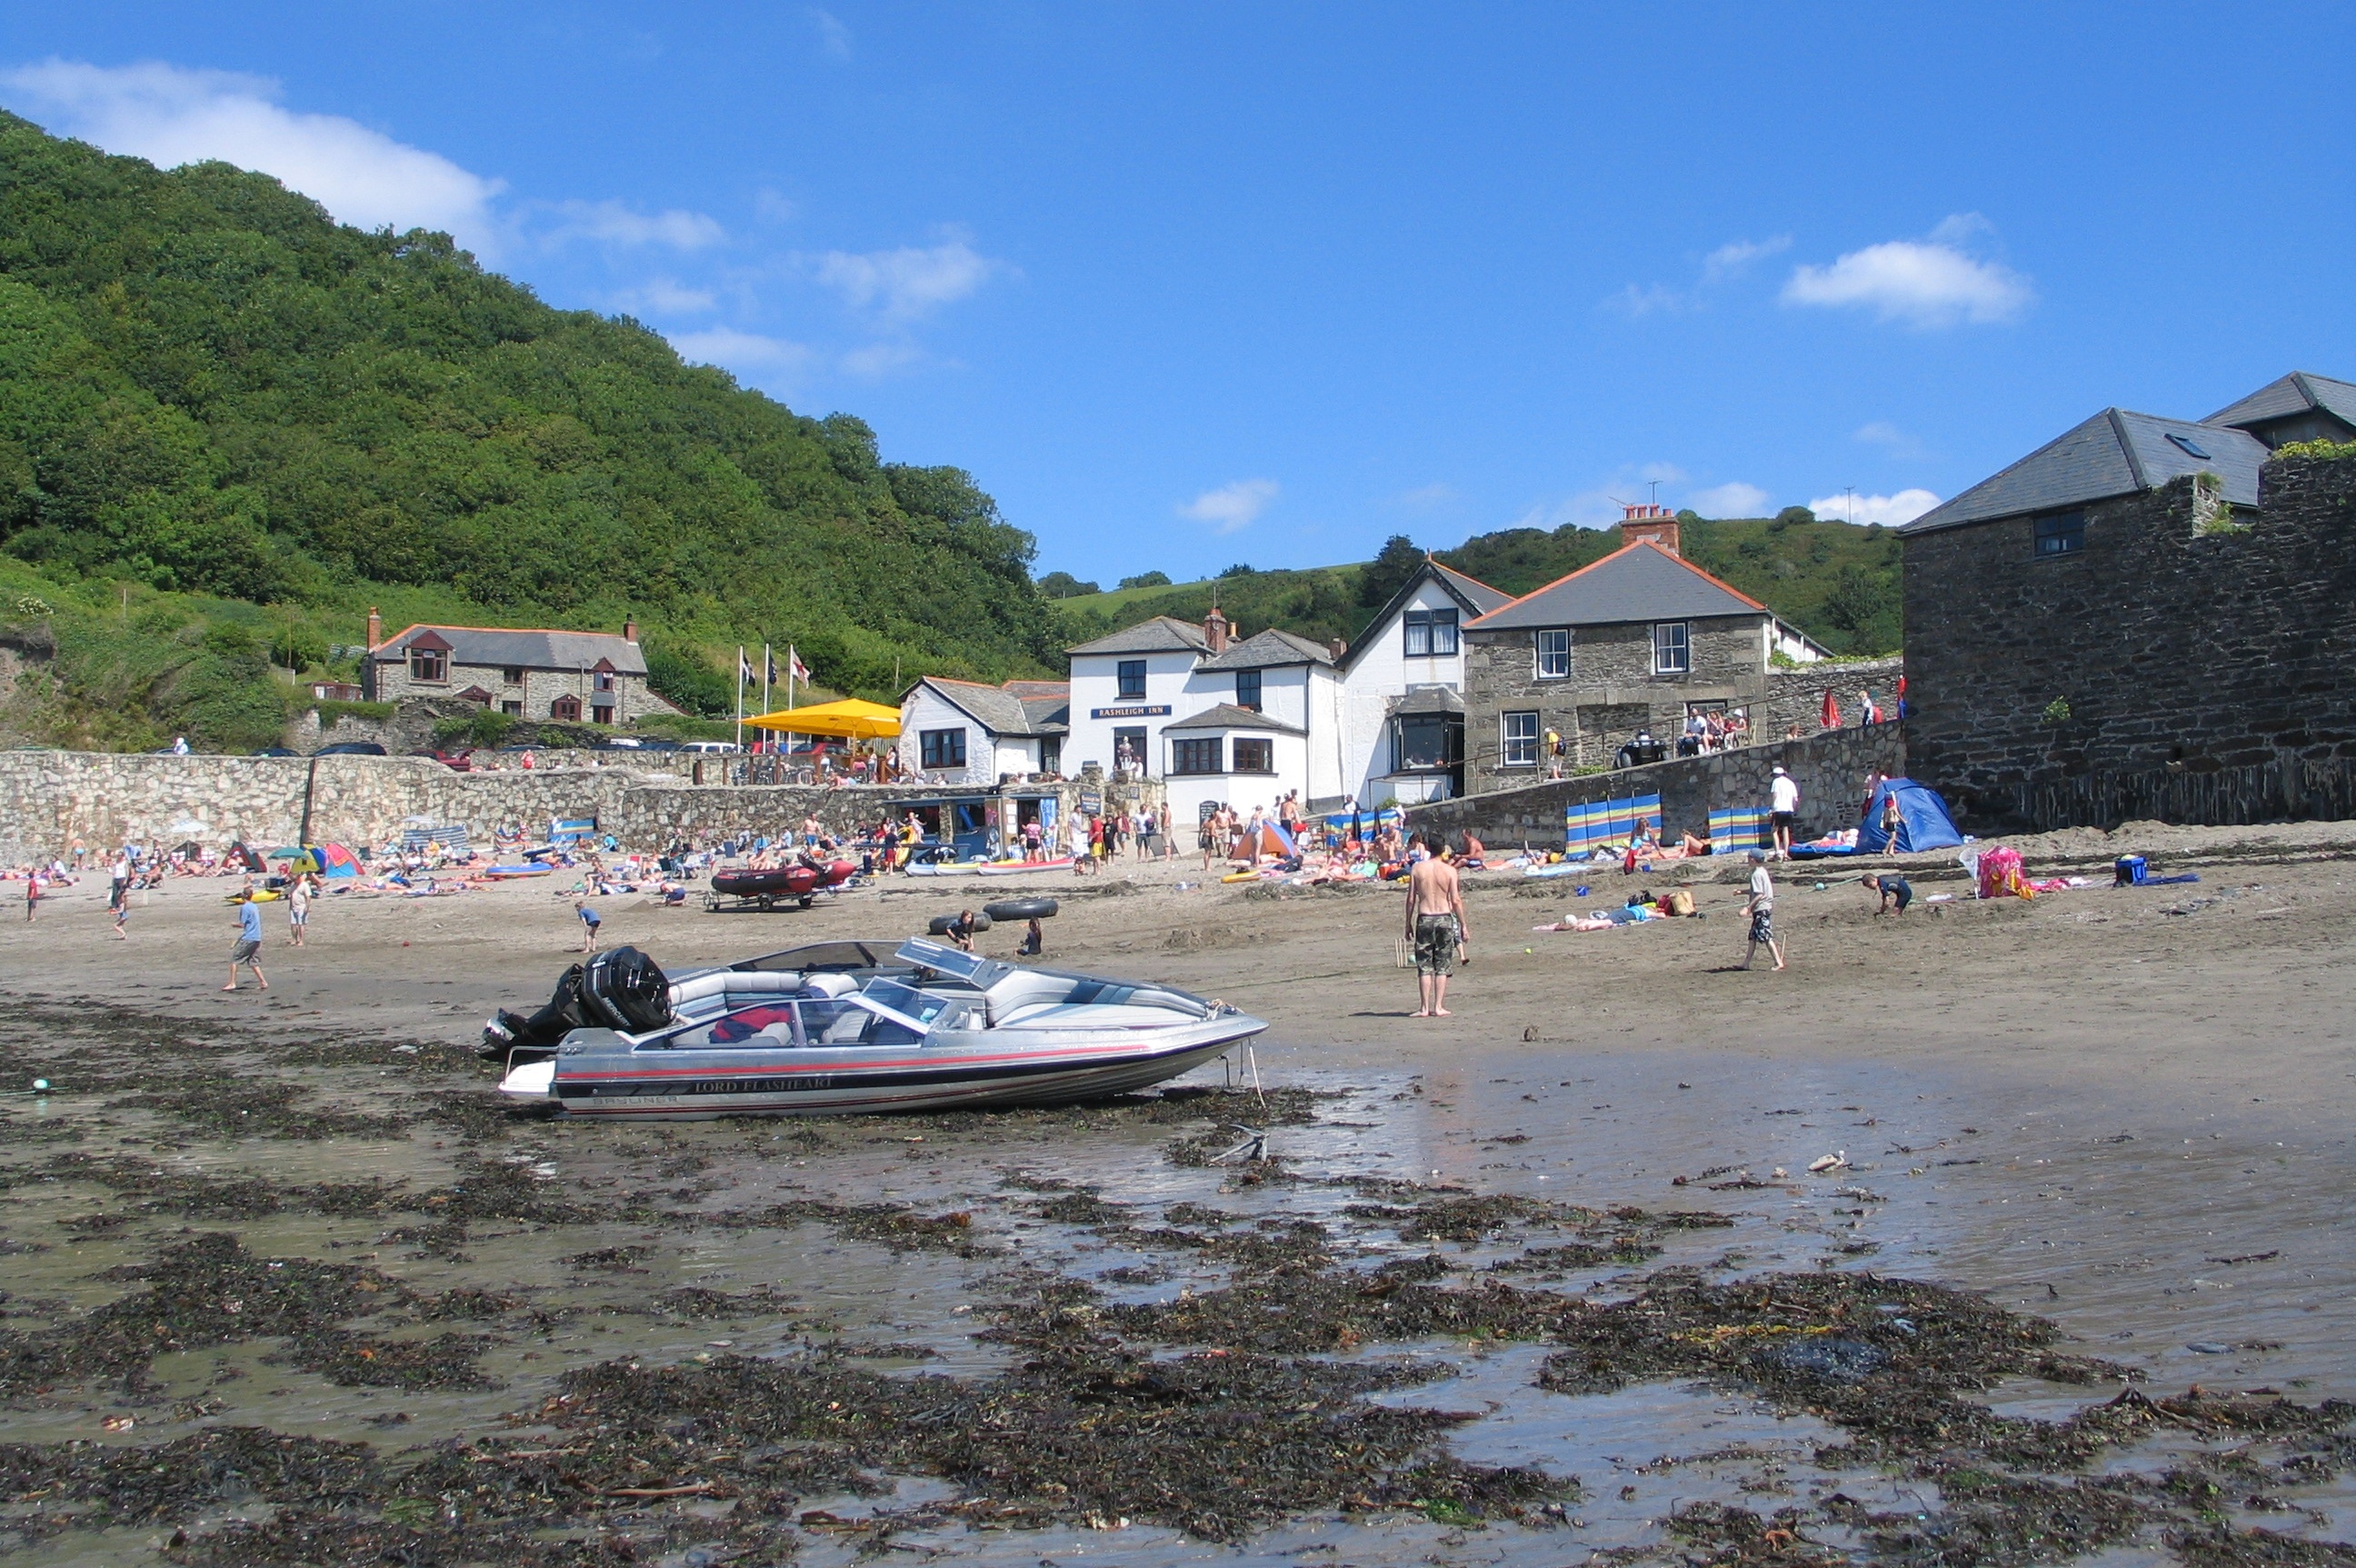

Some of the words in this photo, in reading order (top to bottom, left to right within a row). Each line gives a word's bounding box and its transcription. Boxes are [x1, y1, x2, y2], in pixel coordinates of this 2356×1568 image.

[601, 996, 632, 1027] MERCURY
[695, 1082, 738, 1093] LORD
[744, 1077, 834, 1091] FLASHEART
